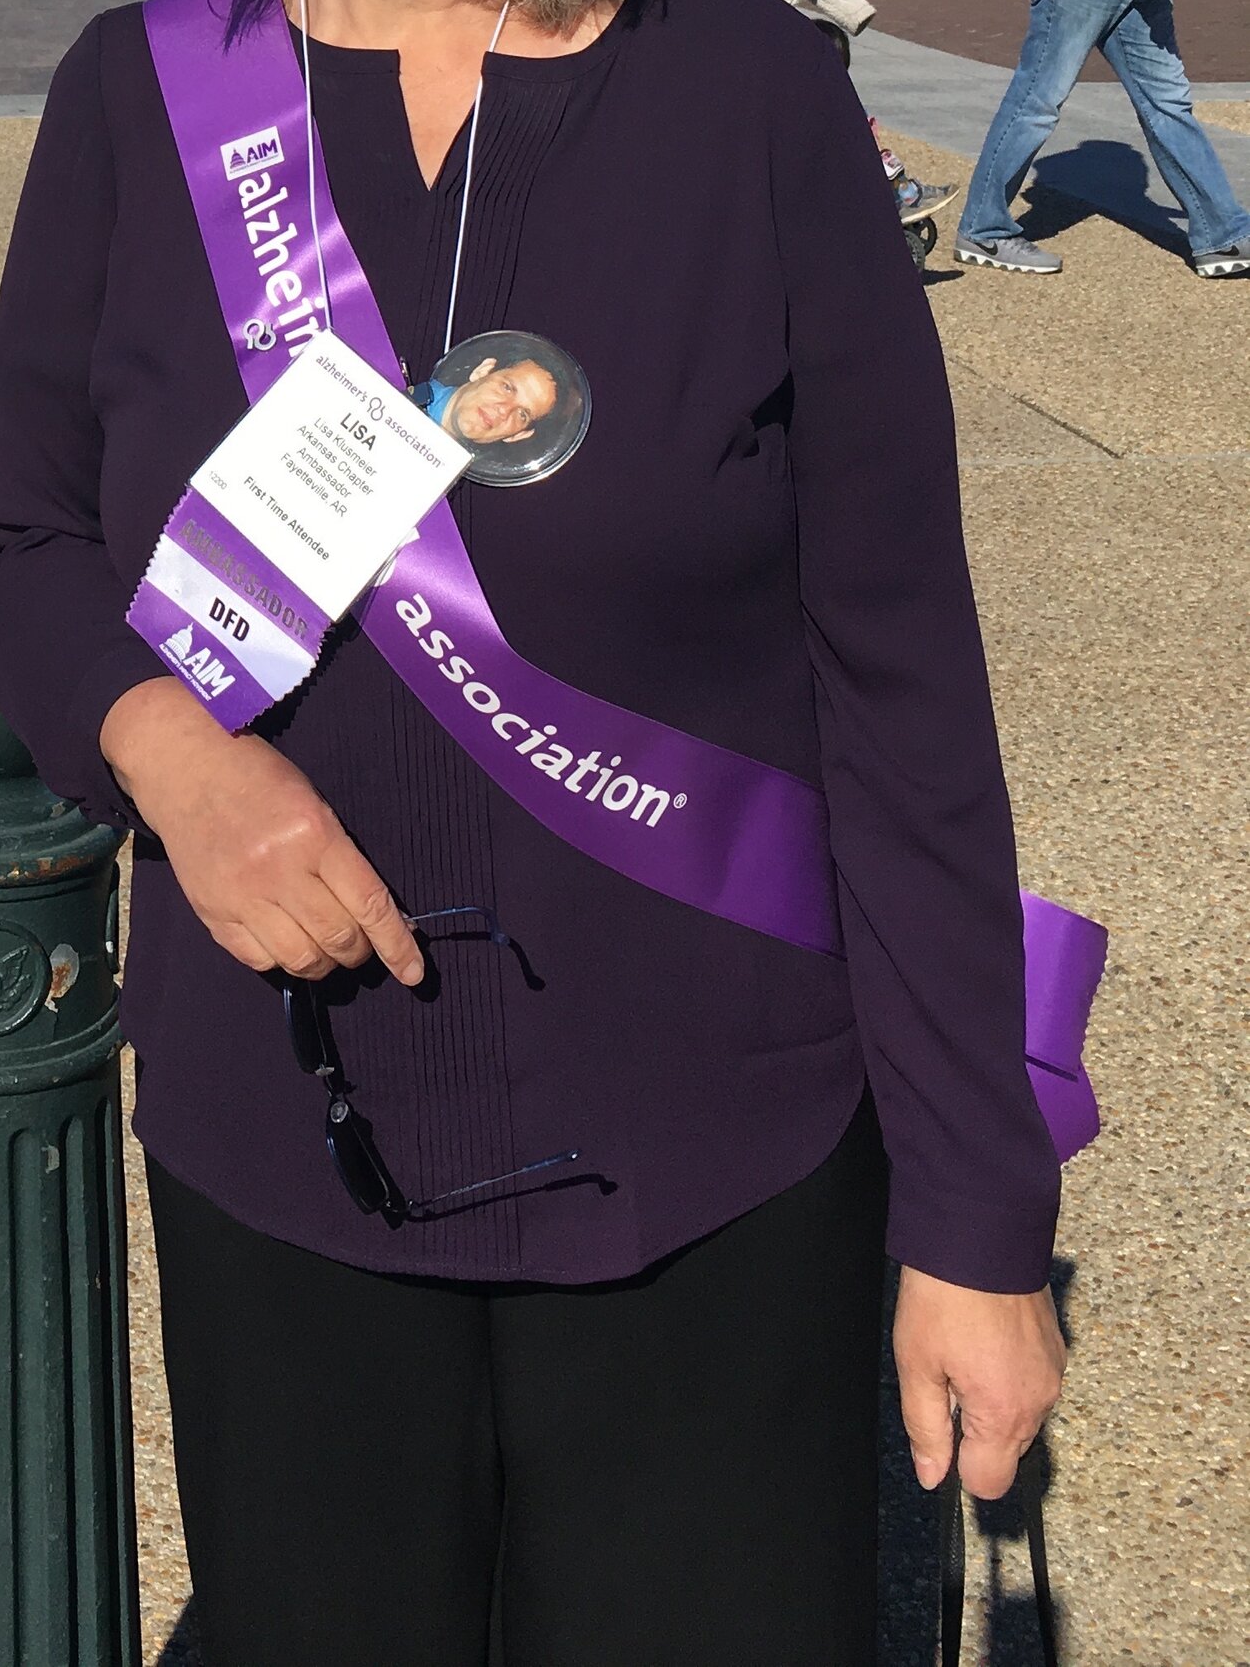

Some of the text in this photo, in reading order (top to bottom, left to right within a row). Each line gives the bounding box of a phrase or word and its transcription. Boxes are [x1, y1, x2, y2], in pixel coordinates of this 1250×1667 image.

[246, 138, 278, 163] AIM
[316, 355, 368, 403] alzheimer's
[313, 417, 334, 439] Lisa
[340, 413, 376, 451] LISA
[296, 425, 374, 495] Arkansas Chapter
[296, 447, 352, 498] Ambassador
[243, 476, 330, 560] First Time Attendee
[329, 500, 348, 517] AR
[181, 519, 308, 640] AMBASSADOR
[208, 596, 250, 642] DFD
[182, 647, 236, 698] AIM
